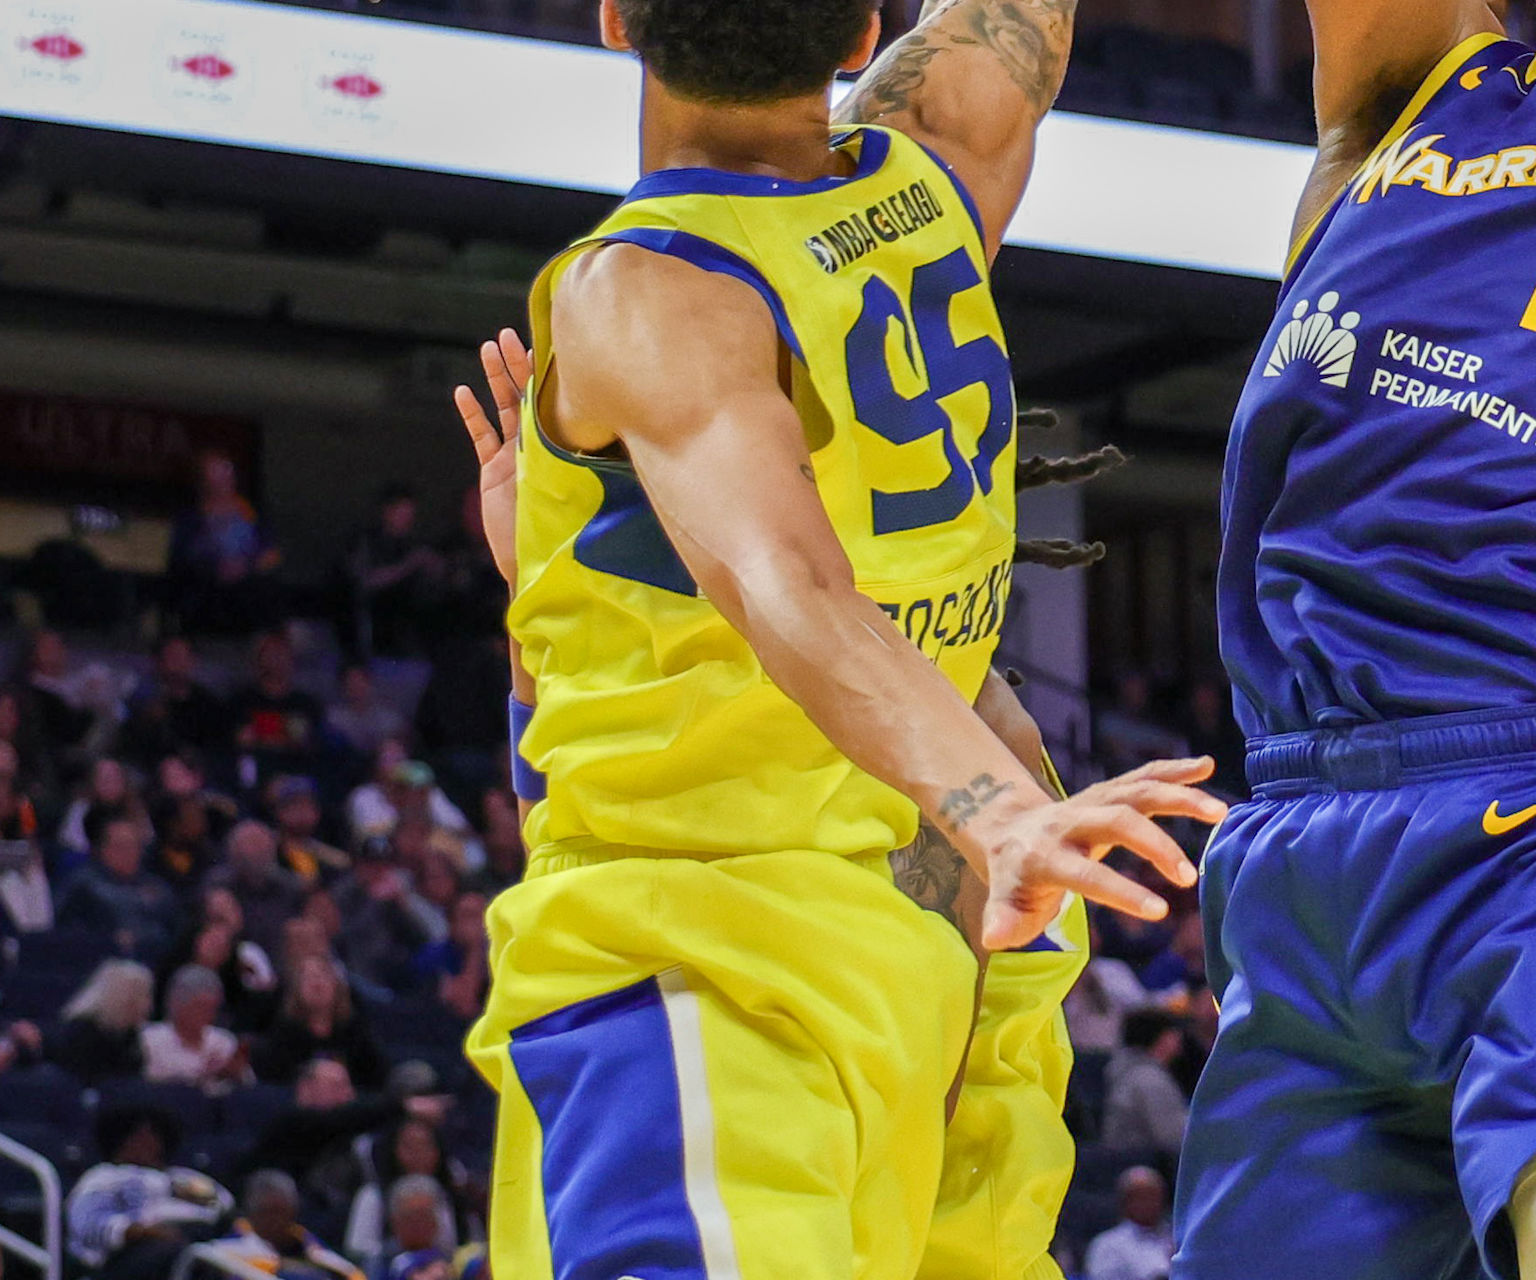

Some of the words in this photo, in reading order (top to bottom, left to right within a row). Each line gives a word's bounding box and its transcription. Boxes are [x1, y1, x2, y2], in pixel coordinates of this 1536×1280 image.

[821, 213, 878, 267] NBA
[880, 179, 944, 236] LEAGU
[845, 251, 1012, 537] 95
[1380, 328, 1484, 383] KAISER
